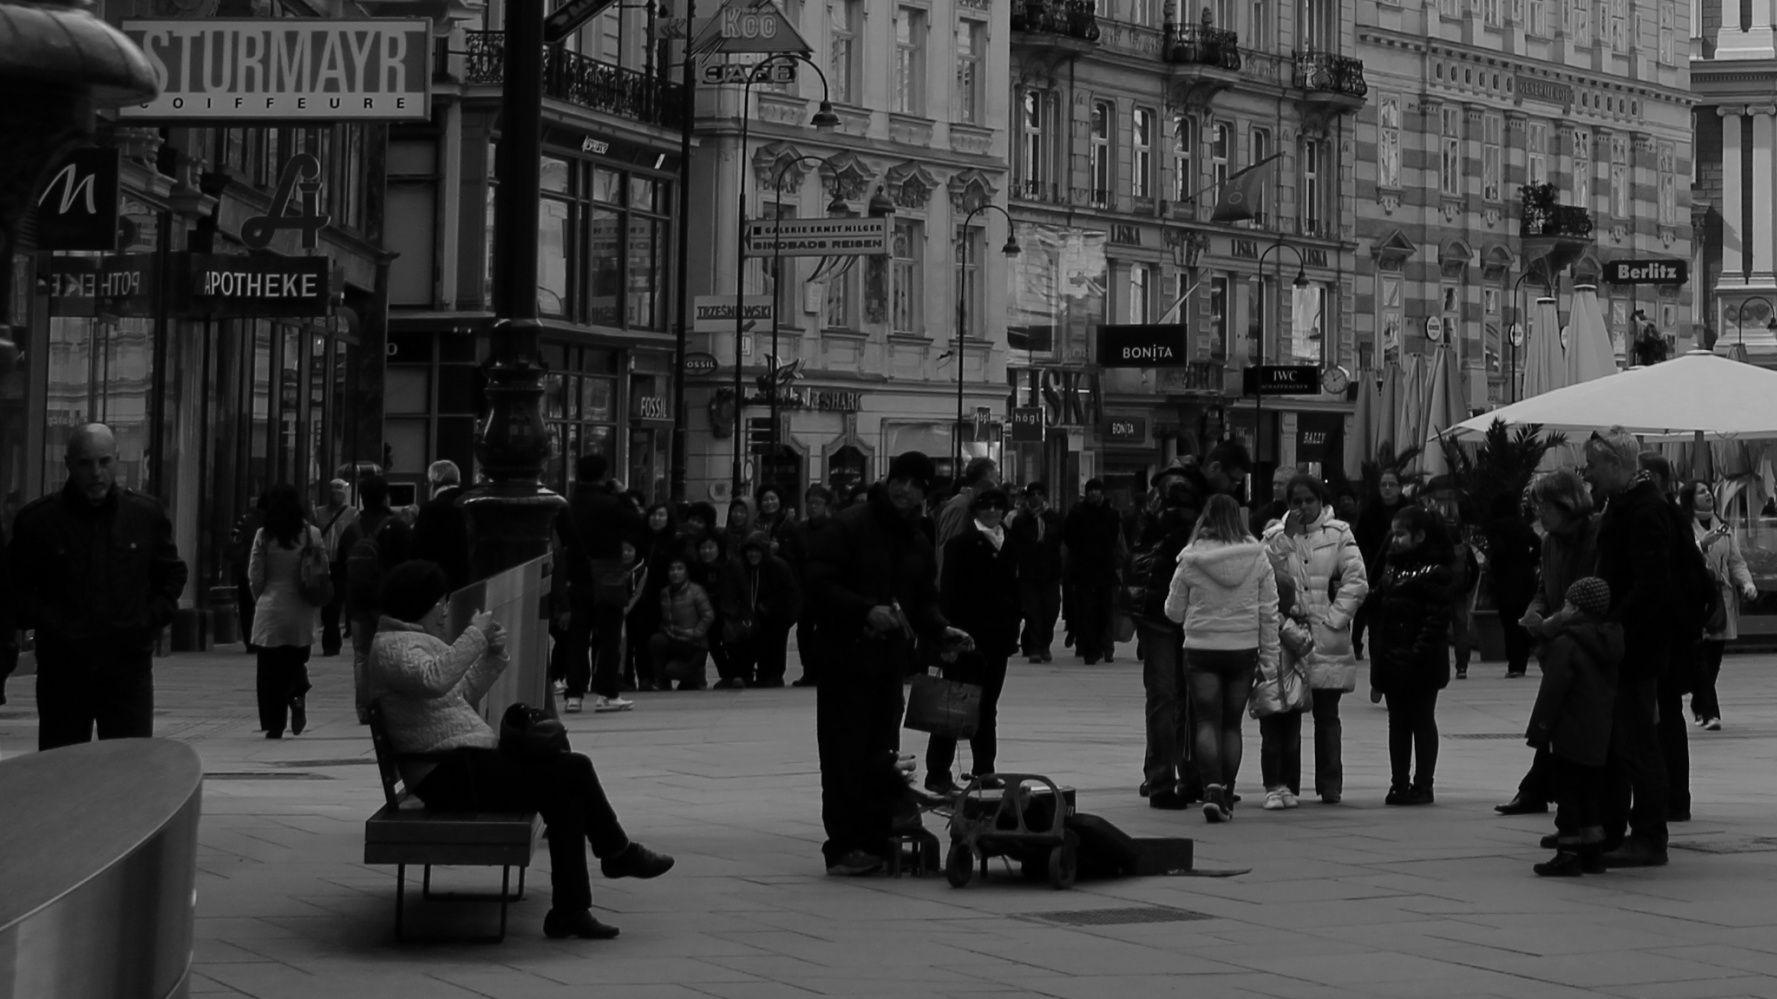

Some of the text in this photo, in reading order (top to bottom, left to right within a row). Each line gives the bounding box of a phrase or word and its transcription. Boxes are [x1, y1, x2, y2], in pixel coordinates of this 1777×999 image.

[142, 28, 408, 94] STURMAYR
[1618, 263, 1677, 279] Berlitz
[204, 271, 318, 297] APOTHEKE
[685, 361, 715, 369] OSSIL
[1273, 370, 1298, 381] IWC
[641, 397, 668, 418] FOSSIL
